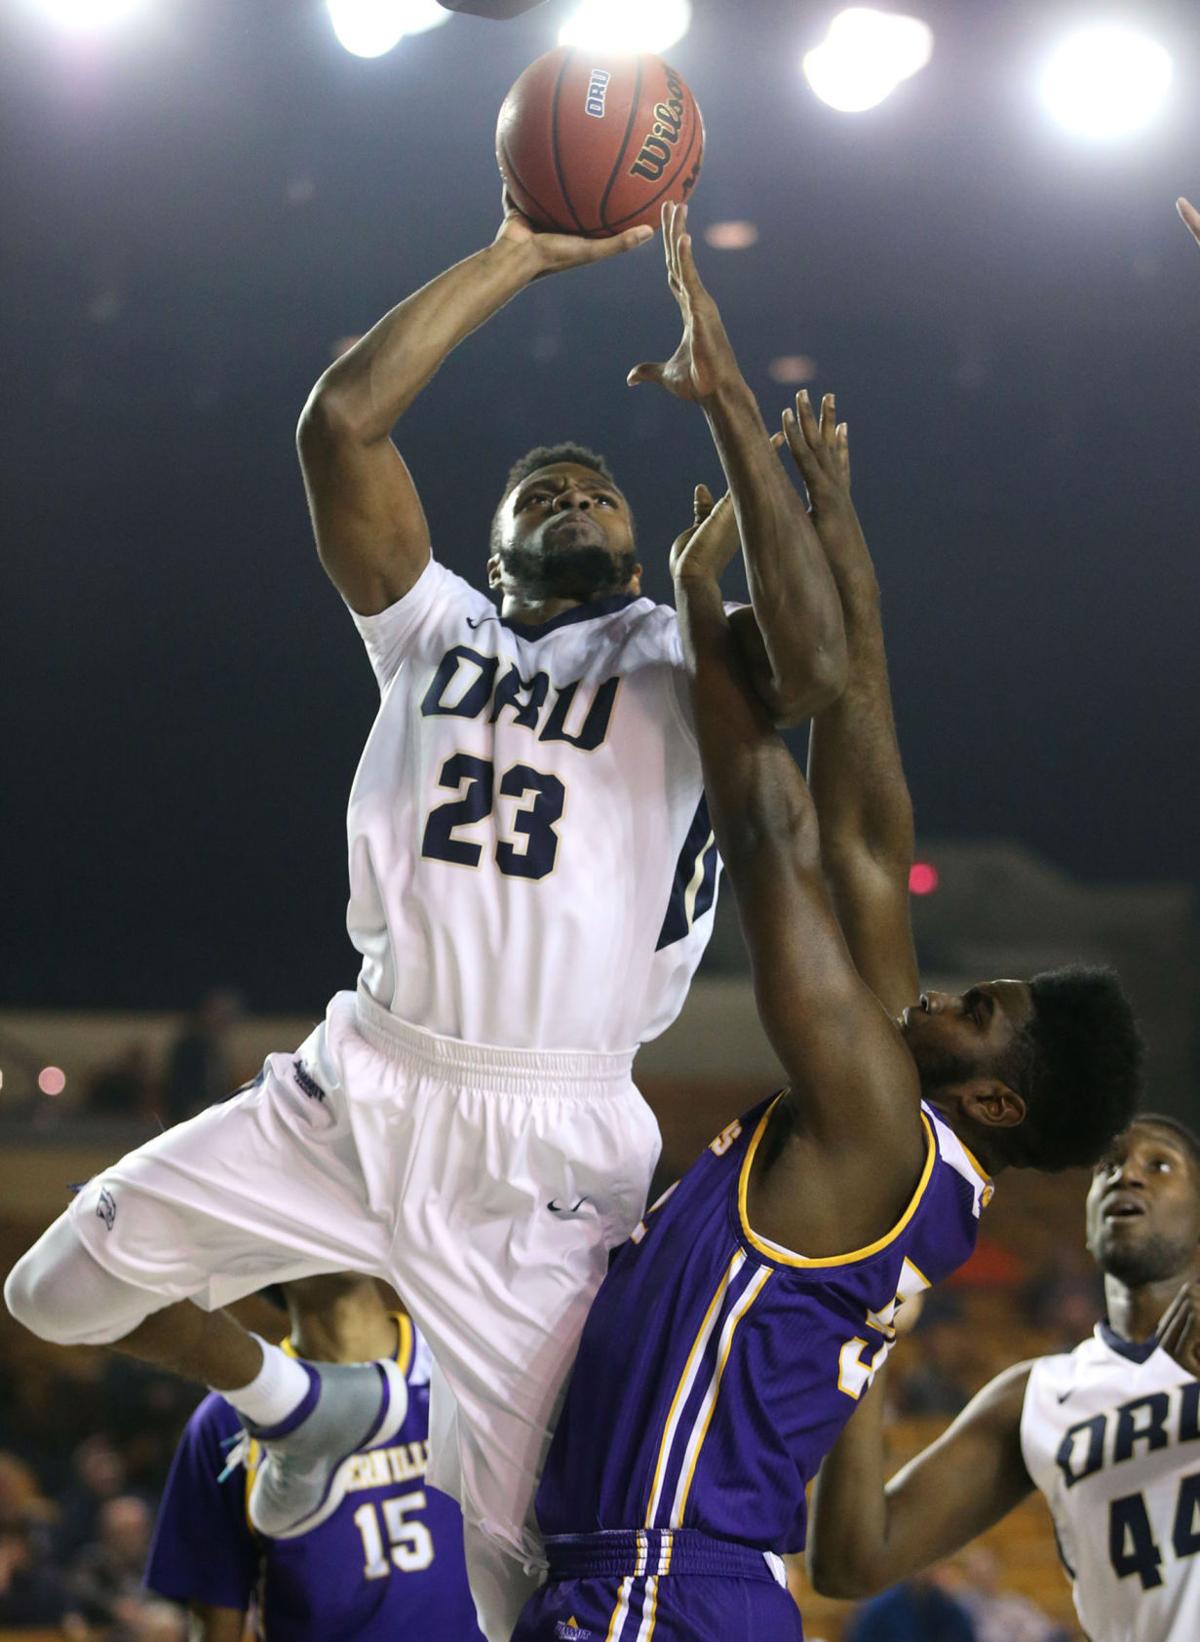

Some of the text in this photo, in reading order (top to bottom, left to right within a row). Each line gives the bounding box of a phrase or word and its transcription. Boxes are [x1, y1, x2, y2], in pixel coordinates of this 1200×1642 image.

[585, 68, 611, 119] ORU
[419, 643, 622, 752] ORU
[419, 752, 567, 881] 23
[353, 1490, 434, 1580] 15
